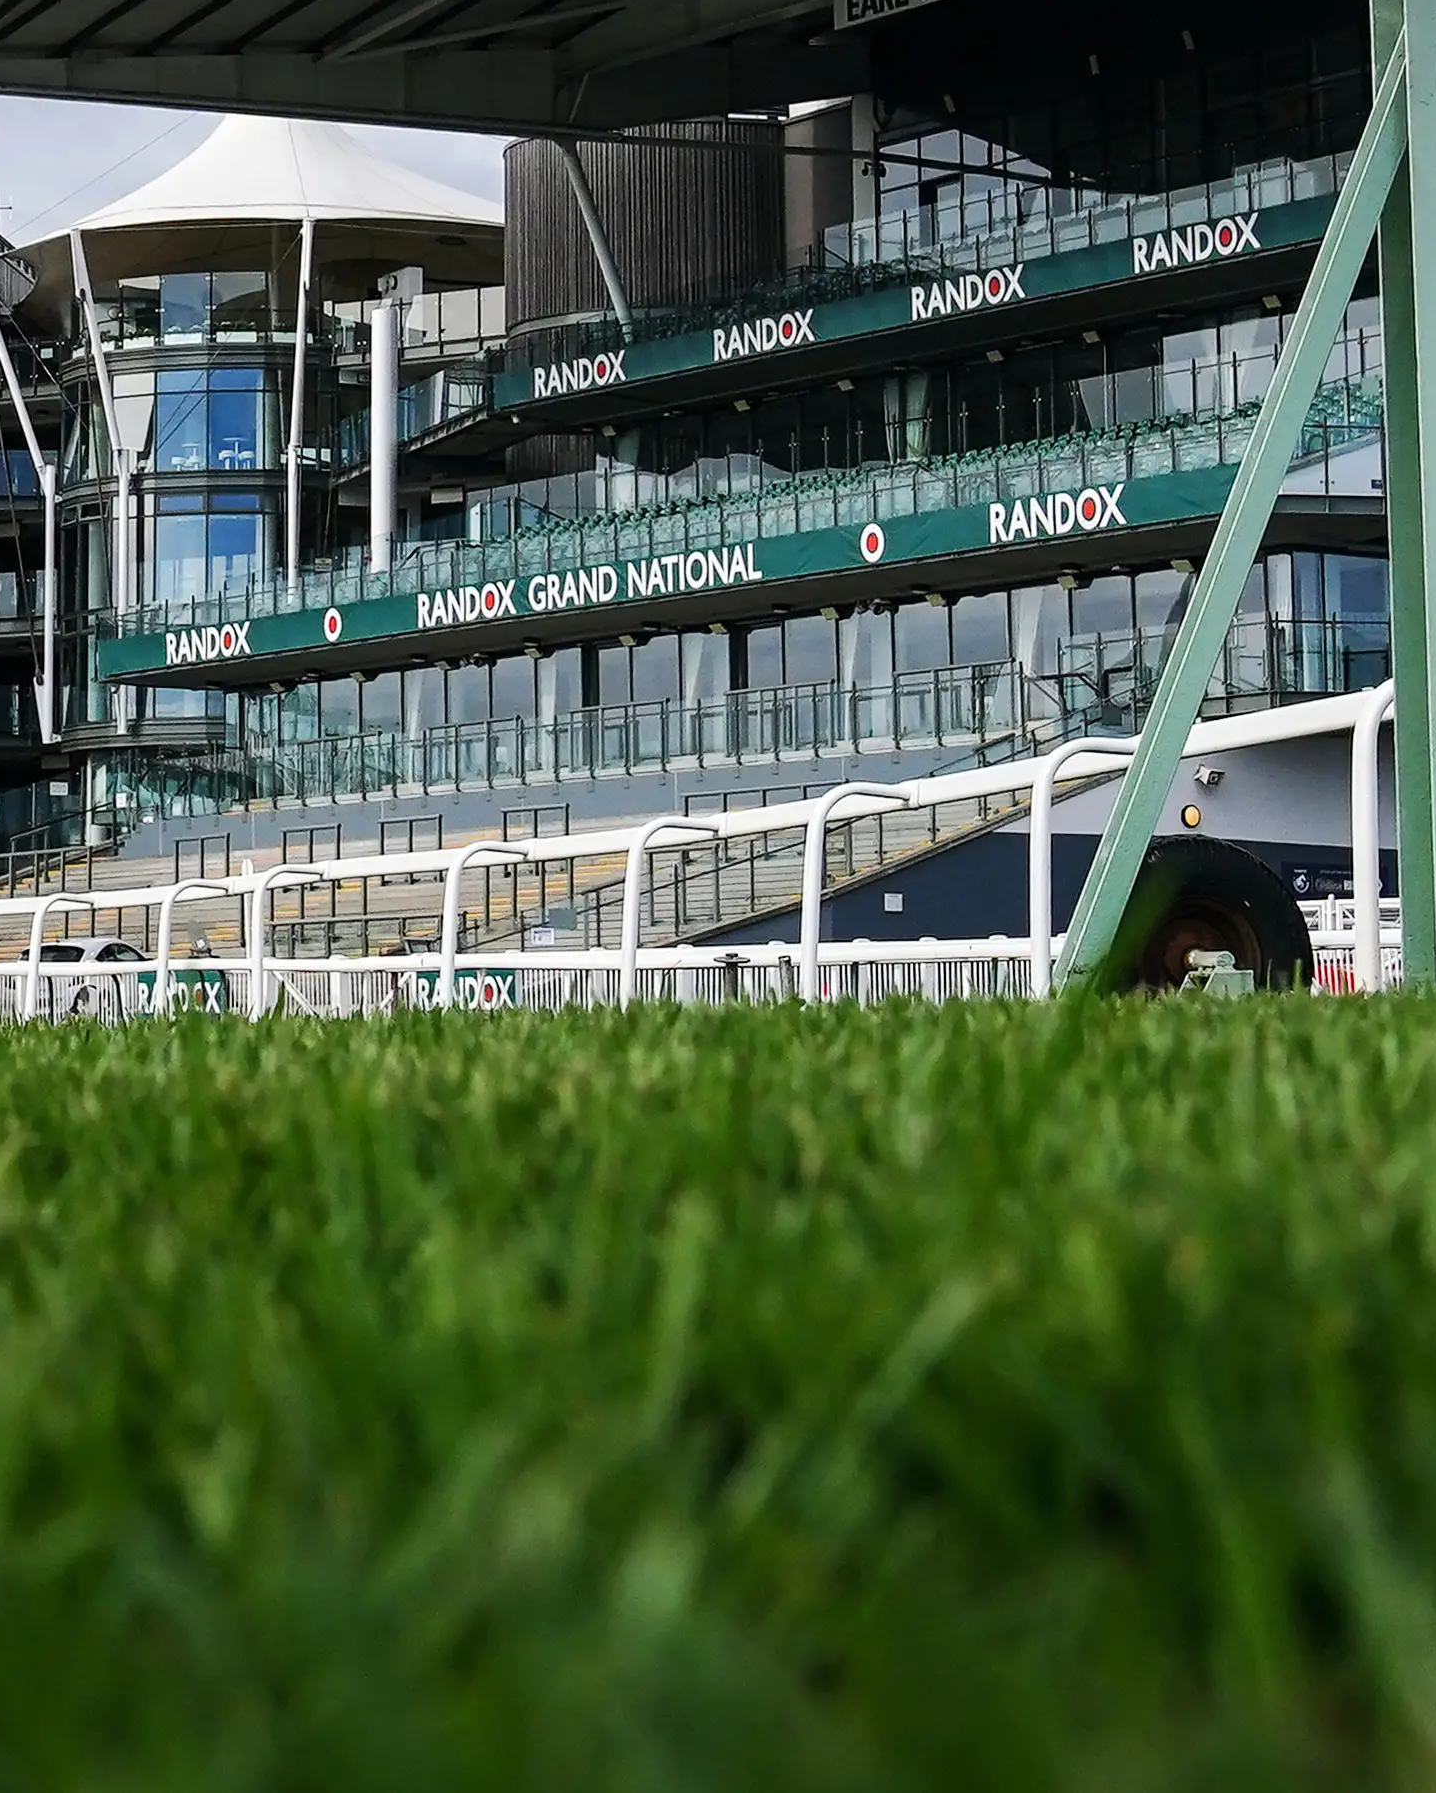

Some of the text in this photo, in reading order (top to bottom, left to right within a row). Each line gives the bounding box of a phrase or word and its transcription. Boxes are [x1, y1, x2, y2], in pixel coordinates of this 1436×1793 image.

[1133, 211, 1261, 274] RANDOX
[912, 264, 1026, 320] RANDOX
[713, 309, 815, 361] RANDOX
[534, 349, 627, 399] RANDOX
[989, 483, 1127, 544] RANDOX
[417, 543, 763, 628] RANDOX GRAND NATIONAL
[165, 620, 252, 666] RANDOX
